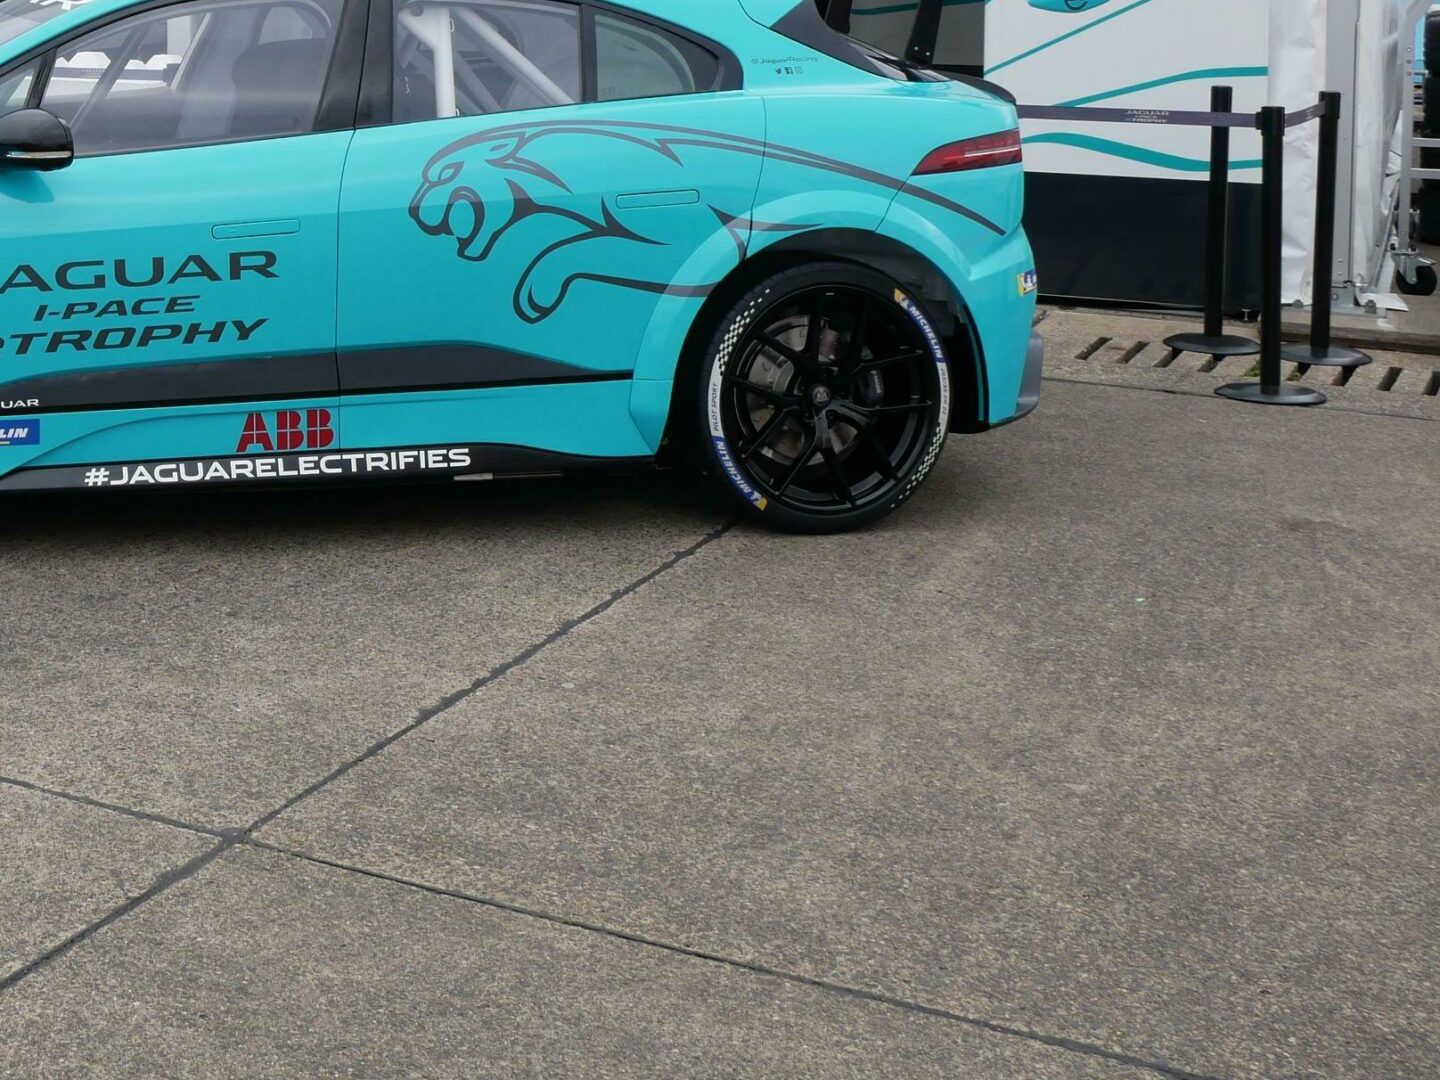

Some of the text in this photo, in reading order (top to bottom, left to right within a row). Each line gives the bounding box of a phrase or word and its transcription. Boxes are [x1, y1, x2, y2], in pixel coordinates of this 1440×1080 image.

[33, 295, 201, 322] I-PACE
[908, 305, 945, 359] MICHELIN
[235, 408, 335, 453] ABB
[84, 448, 472, 487] #JAGUARELECTRIFIES
[715, 440, 752, 493] MICHELIN
